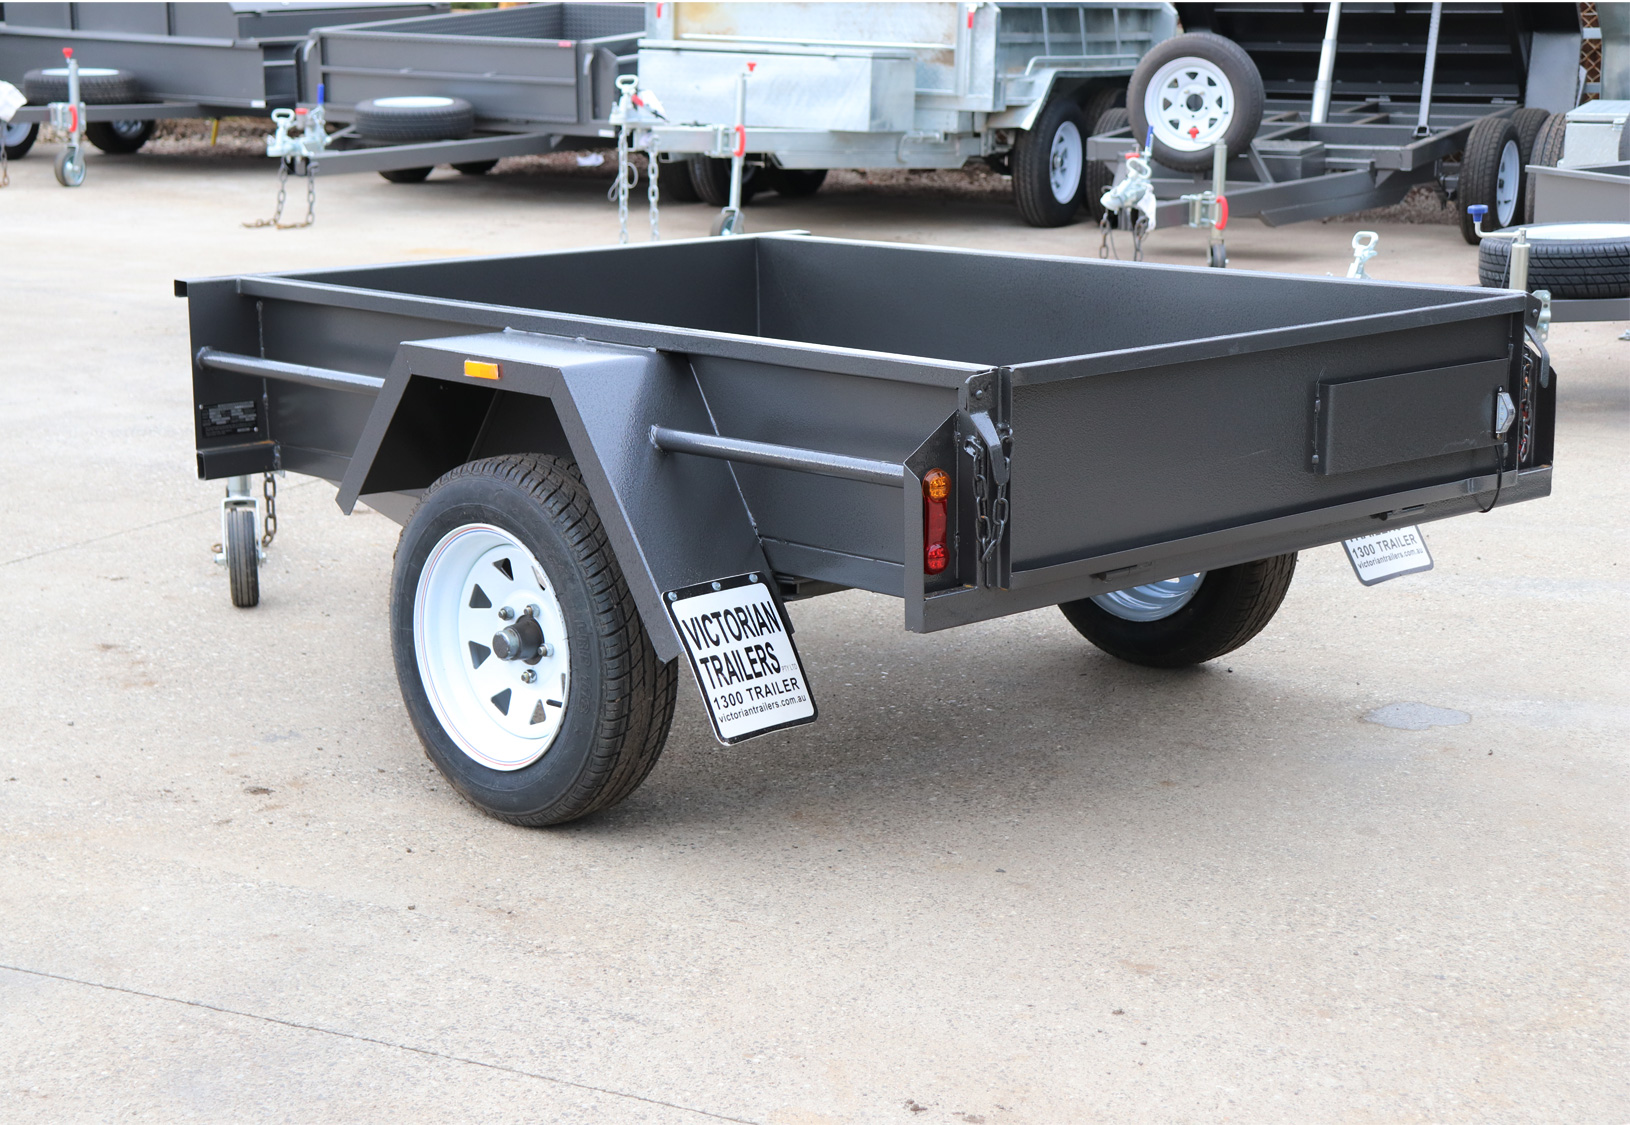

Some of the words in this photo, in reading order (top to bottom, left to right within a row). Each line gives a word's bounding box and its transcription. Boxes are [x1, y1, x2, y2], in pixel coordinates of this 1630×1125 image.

[1352, 543, 1376, 559] 1300
[1376, 533, 1418, 552] TRAILER
[682, 600, 782, 651] VICTORIAN
[699, 641, 782, 689] TRAILERS
[713, 691, 743, 710] 1300
[746, 677, 801, 702] TRAILER
[718, 694, 807, 723] victoriantrailers.com.au
